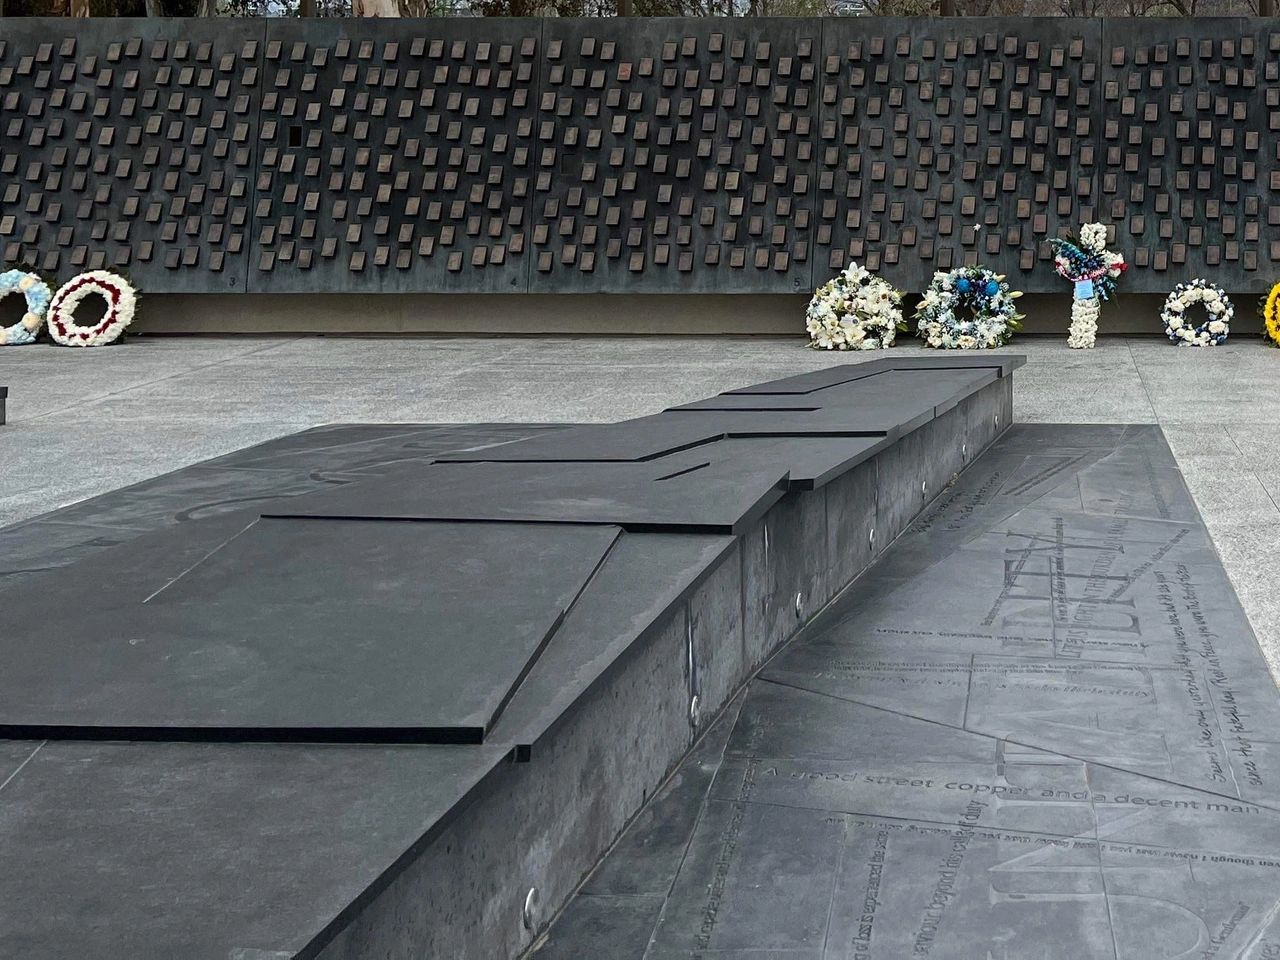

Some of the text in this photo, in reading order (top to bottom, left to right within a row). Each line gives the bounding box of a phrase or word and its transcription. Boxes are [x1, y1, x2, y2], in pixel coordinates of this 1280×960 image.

[864, 774, 935, 788] street
[944, 781, 1031, 795] copper
[1041, 787, 1089, 800] and
[1093, 792, 1107, 802] a
[1114, 794, 1201, 810] decent
[1207, 803, 1260, 815] man
[923, 871, 956, 910] beyond
